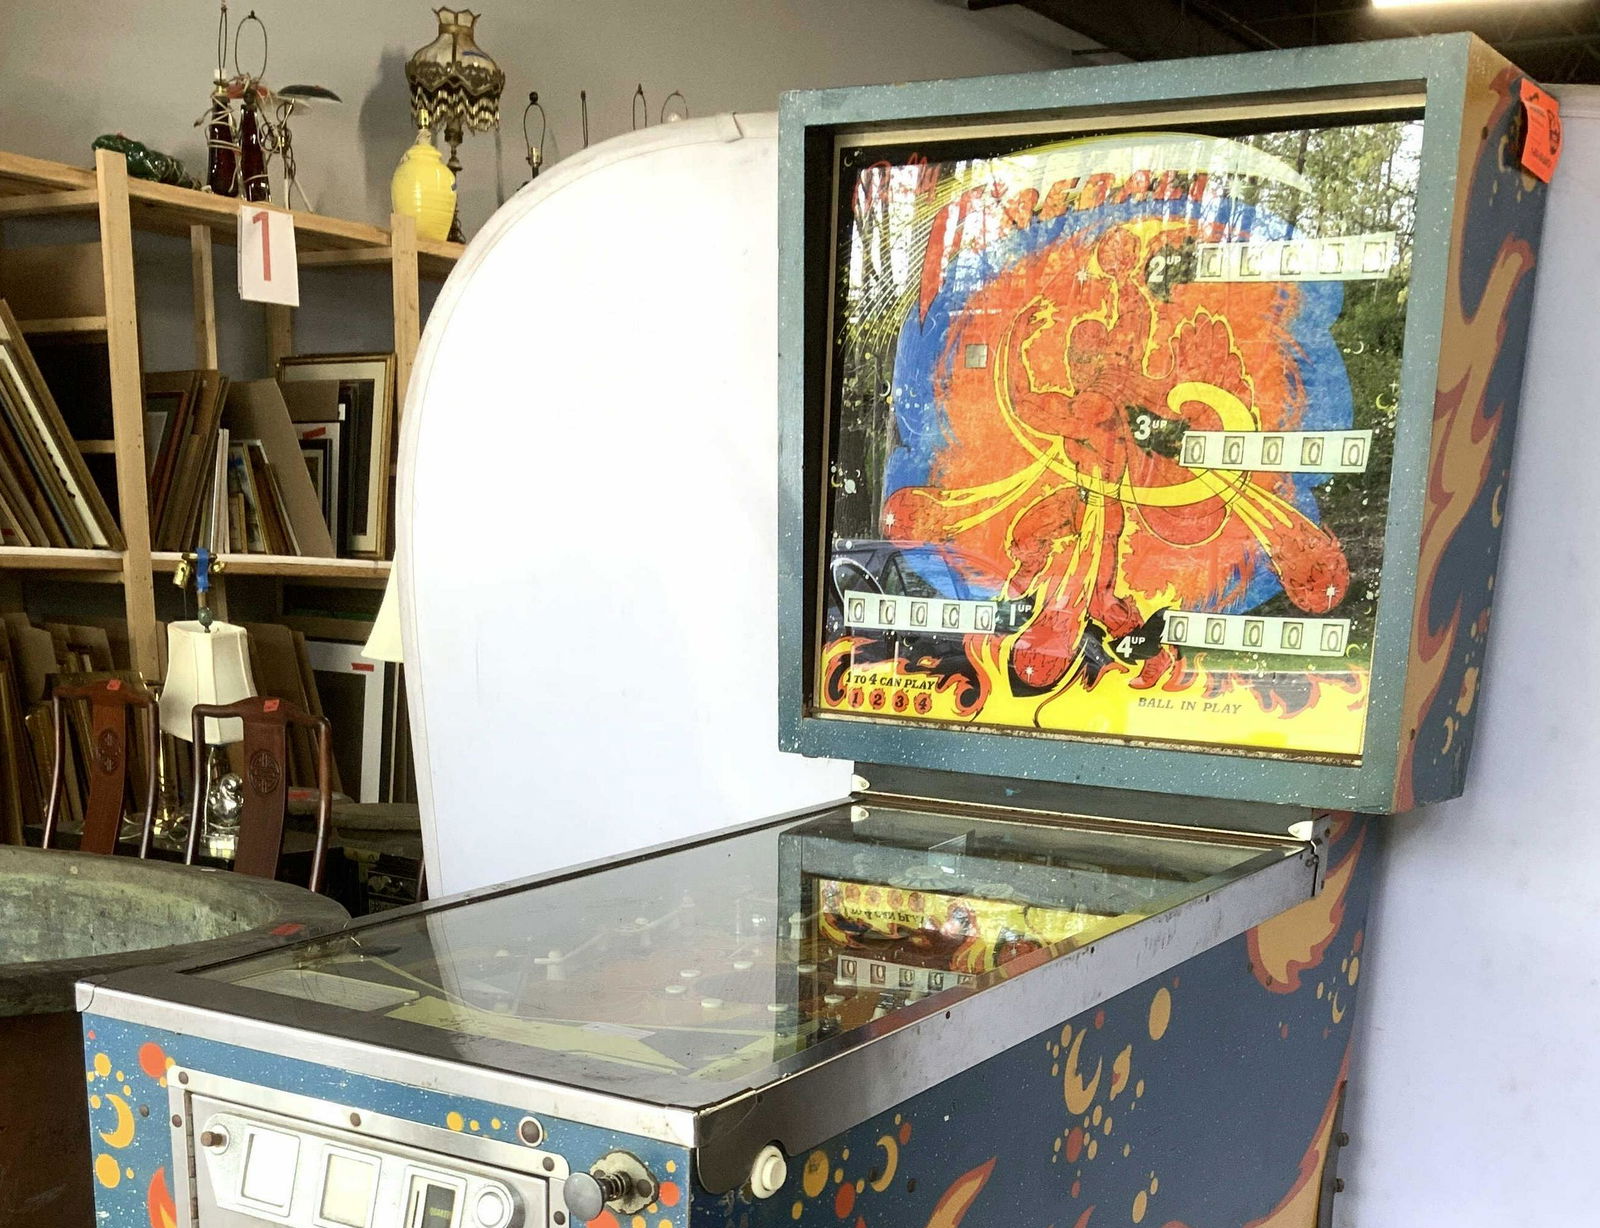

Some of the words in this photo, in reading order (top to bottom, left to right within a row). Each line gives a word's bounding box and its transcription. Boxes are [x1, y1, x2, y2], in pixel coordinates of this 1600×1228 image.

[252, 211, 272, 282] 1
[846, 672, 852, 683] 1
[854, 675, 867, 684] TO
[869, 673, 877, 685] 4
[880, 677, 902, 687] CAN
[904, 679, 936, 690] PLAY
[852, 692, 859, 704] 1
[874, 693, 883, 706] 2
[895, 695, 905, 708] 3
[918, 697, 928, 710] 4
[1138, 697, 1174, 709] BALL
[1180, 700, 1197, 711] IN
[1203, 702, 1242, 714] PLAY
